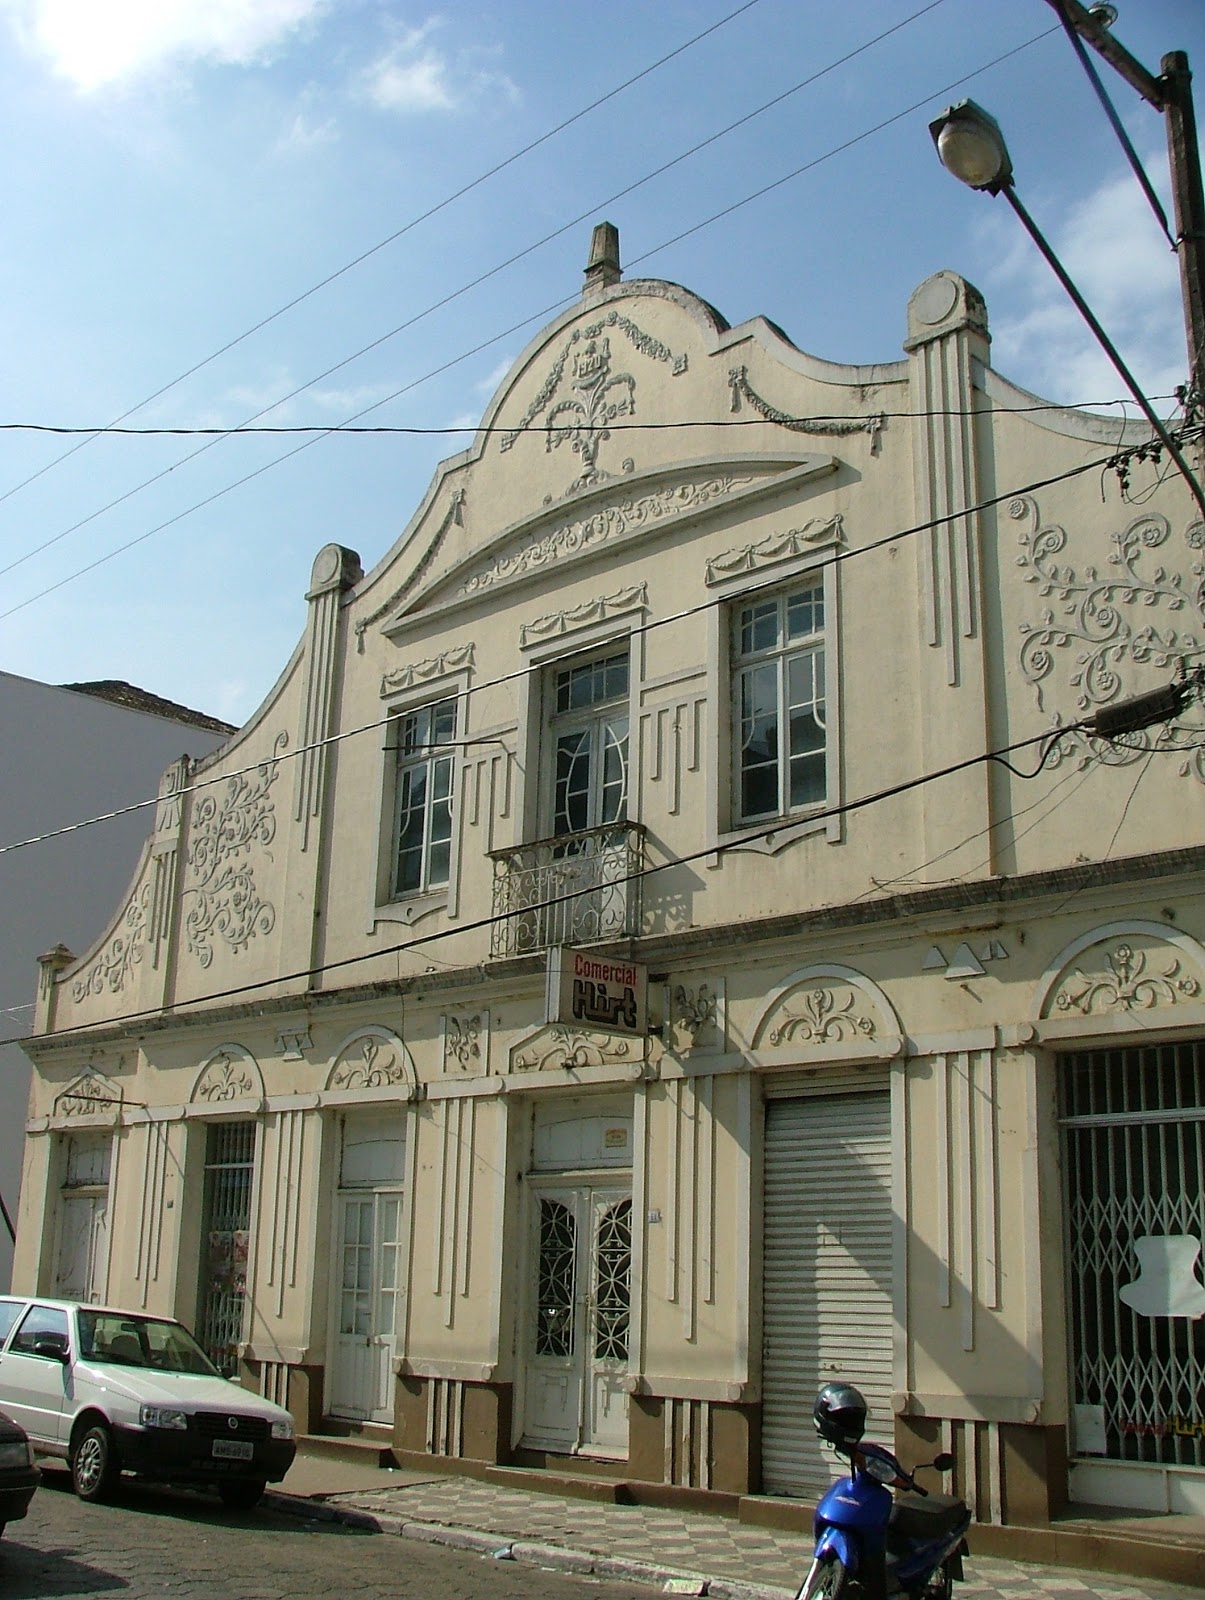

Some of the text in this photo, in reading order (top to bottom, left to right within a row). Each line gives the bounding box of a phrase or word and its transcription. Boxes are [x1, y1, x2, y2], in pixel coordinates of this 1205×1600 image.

[577, 355, 601, 378] 1920
[574, 954, 638, 986] Comercial
[572, 979, 637, 1028] Hirt
